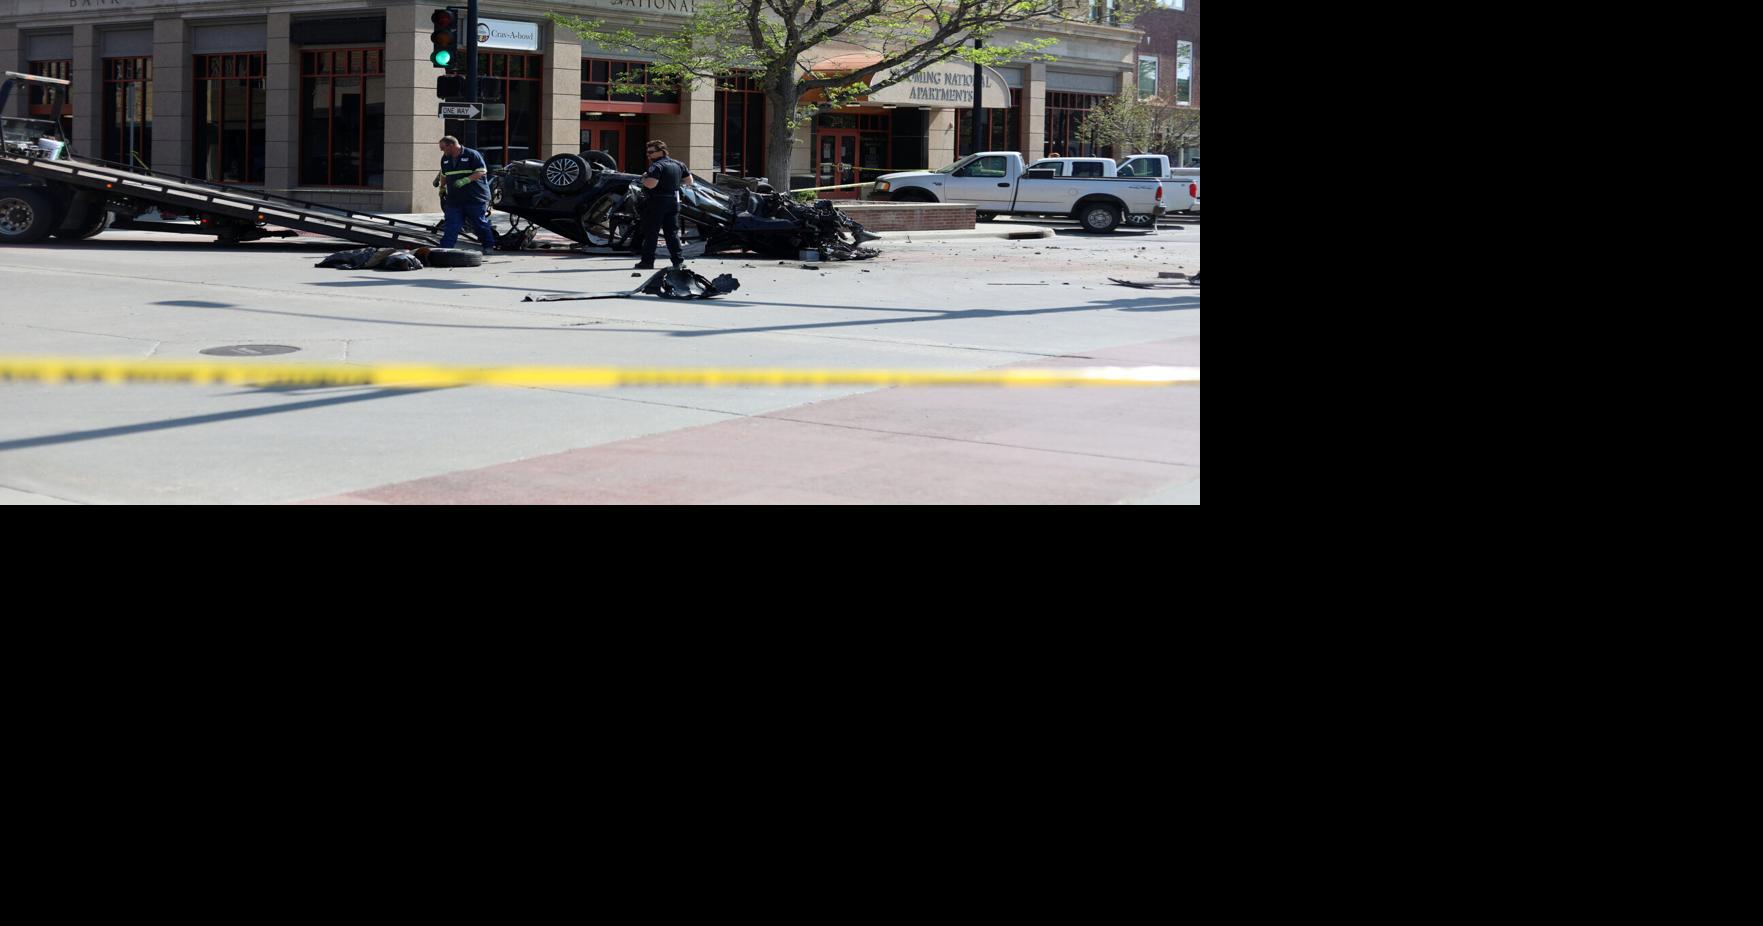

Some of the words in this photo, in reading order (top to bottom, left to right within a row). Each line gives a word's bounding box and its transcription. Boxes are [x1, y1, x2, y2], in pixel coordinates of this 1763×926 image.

[944, 73, 993, 88] NATIOAL
[909, 87, 974, 103] APARTMENTS
[457, 107, 469, 115] WAY
